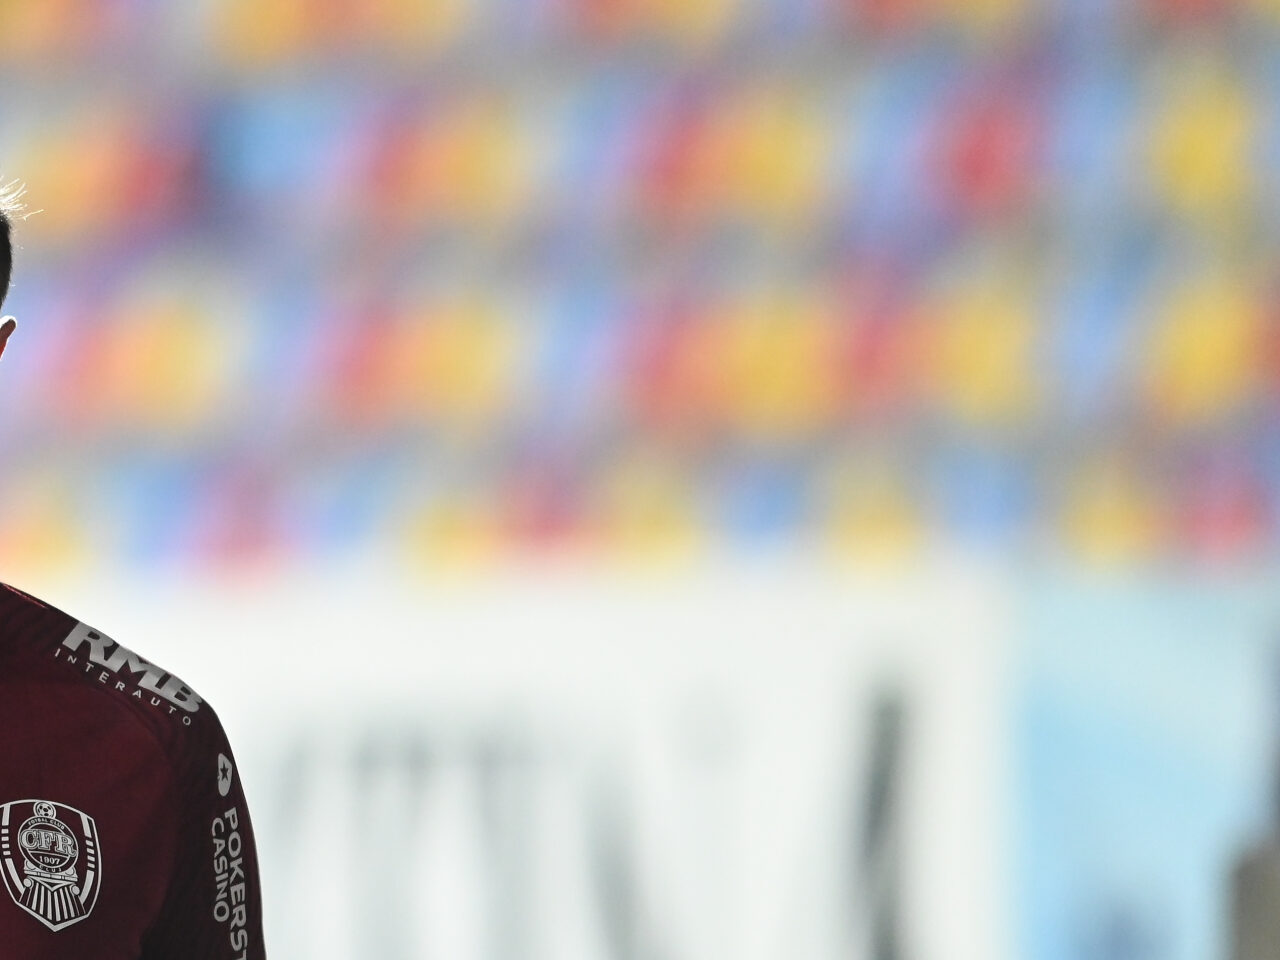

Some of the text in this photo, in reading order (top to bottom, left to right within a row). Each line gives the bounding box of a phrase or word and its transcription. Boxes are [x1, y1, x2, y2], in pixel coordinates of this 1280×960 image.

[54, 648, 192, 726] INTERAUTO
[62, 621, 203, 713] RMB
[19, 828, 77, 857] CFR
[39, 856, 60, 865] 1907
[211, 817, 230, 922] CASINO
